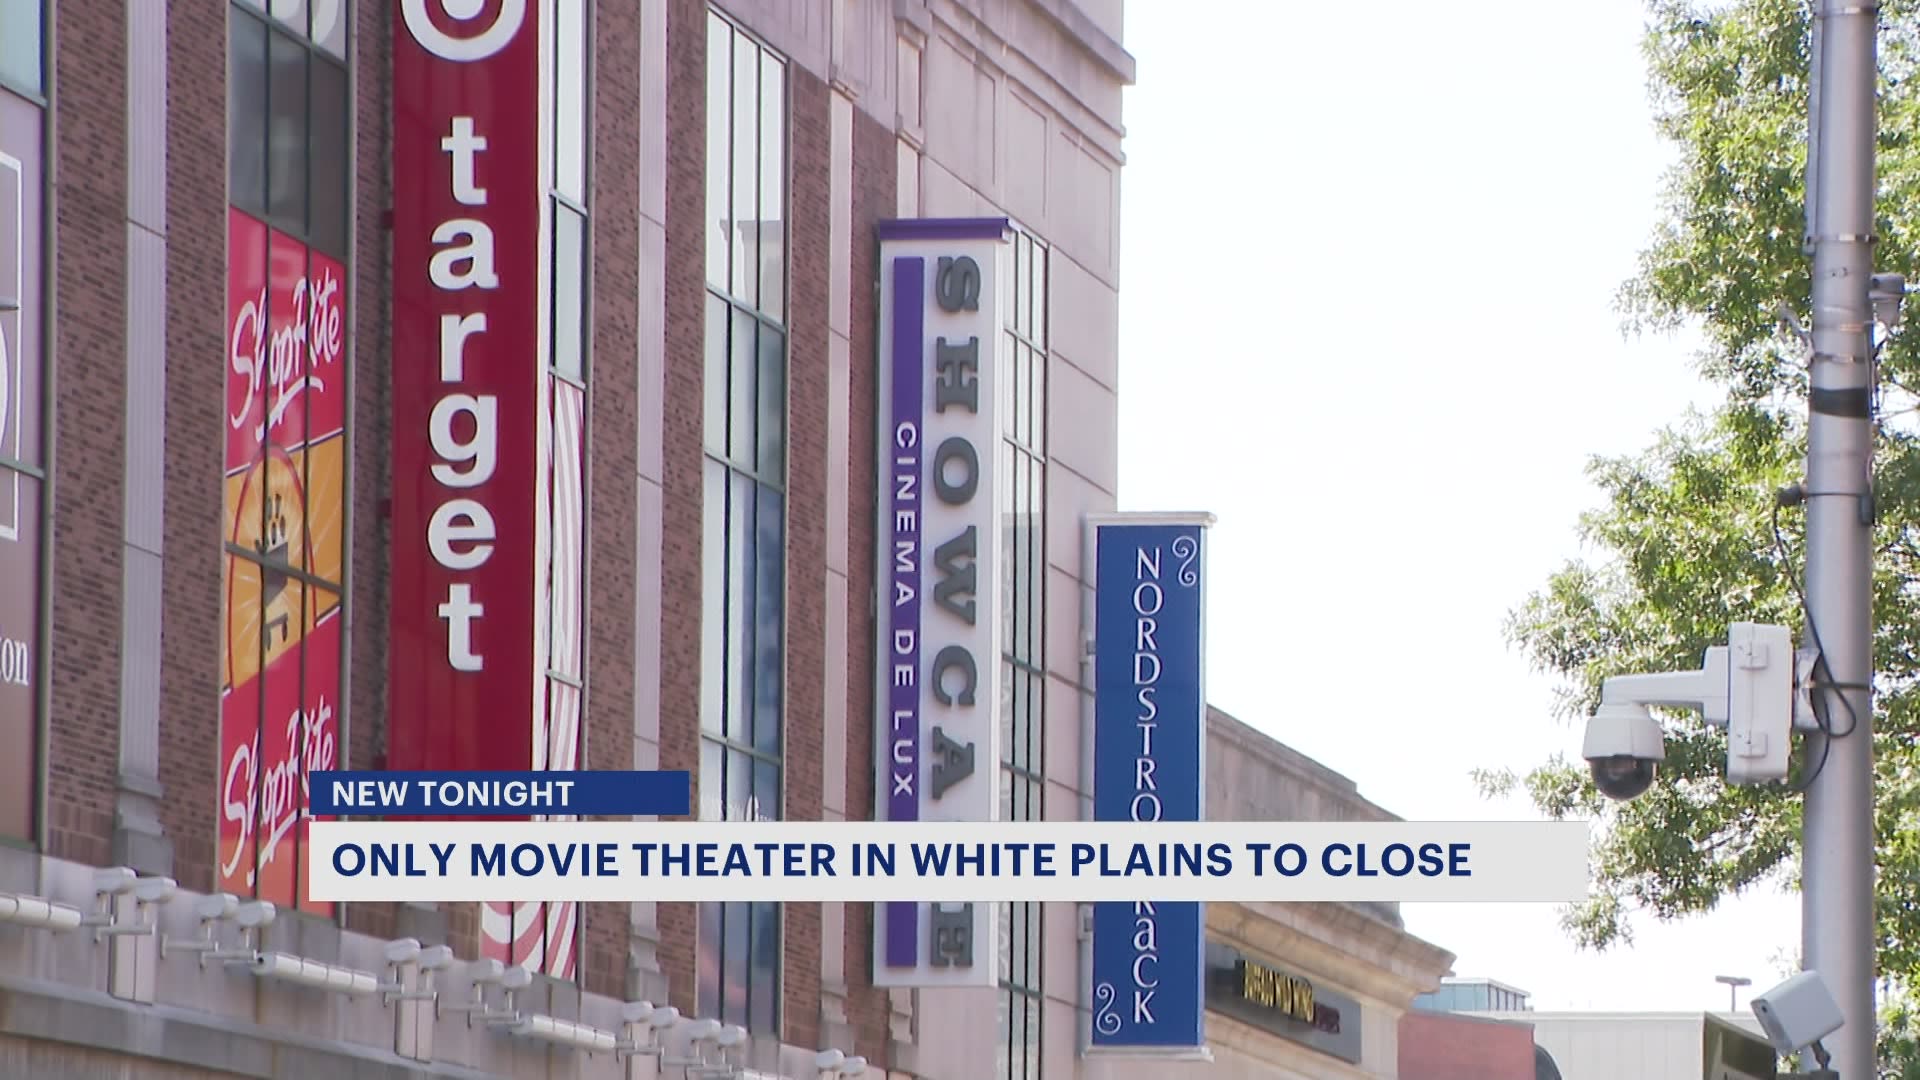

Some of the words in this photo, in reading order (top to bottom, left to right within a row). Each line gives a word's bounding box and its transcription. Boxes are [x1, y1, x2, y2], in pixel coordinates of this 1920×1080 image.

[231, 266, 341, 432] ShopRite
[428, 117, 500, 672] target
[895, 422, 916, 608] CINEMA
[931, 255, 981, 969] SHOWCAE
[895, 630, 914, 687] DE
[1131, 548, 1164, 822] NORDSTRO
